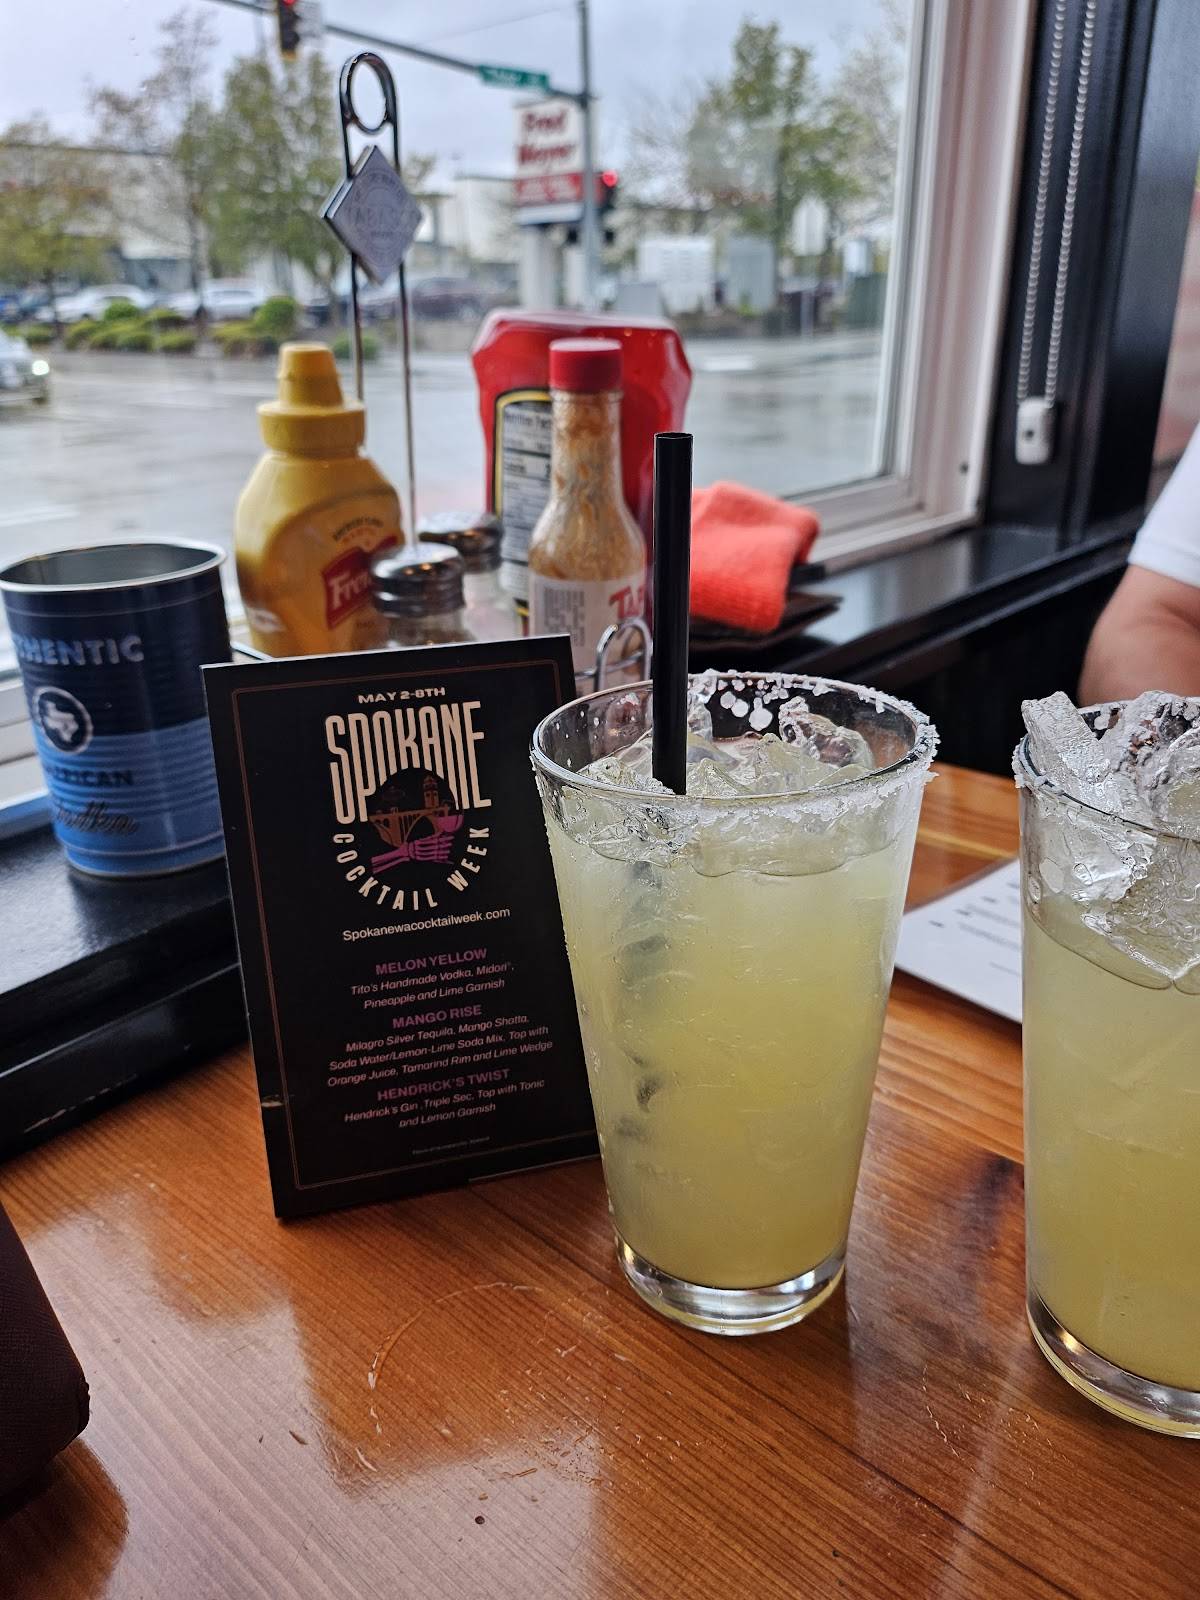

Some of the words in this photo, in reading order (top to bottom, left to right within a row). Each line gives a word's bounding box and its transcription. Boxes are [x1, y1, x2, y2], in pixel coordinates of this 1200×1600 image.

[358, 691, 397, 704] MAY
[400, 687, 446, 700] 2-8TH
[325, 701, 492, 824] SPOKANE
[333, 833, 438, 911] COCKTAIL
[447, 827, 490, 892] WEEK
[342, 908, 511, 941] Spokanewacocktailweek.com
[375, 957, 427, 976] MELON
[429, 948, 488, 966] YELLOW
[351, 982, 378, 996] Tito's
[381, 973, 437, 991] Handmade
[364, 993, 416, 1010] Pineapple
[417, 988, 437, 1001] and
[439, 985, 463, 998] Lime
[466, 978, 505, 994] Garnish
[392, 1010, 447, 1029] MANGO
[449, 1004, 482, 1021] RISE
[328, 1058, 357, 1072] Soda
[360, 1043, 455, 1067] Water/Lemon-Lime
[457, 1037, 484, 1050] Soda
[508, 1029, 527, 1043] Top
[528, 1025, 549, 1038] with
[345, 1038, 384, 1053] Milagro
[386, 1033, 416, 1046] Silver
[458, 1020, 492, 1035] Mango
[327, 1072, 367, 1088] Orange
[401, 1058, 449, 1075] Tamarind
[451, 1053, 472, 1067] Rim
[473, 1049, 492, 1062] and
[493, 1044, 518, 1058] Lime
[519, 1039, 553, 1054] Wedge
[344, 1105, 398, 1122] Hendrick's
[400, 1101, 418, 1114] Gin
[477, 1087, 496, 1101] Top
[497, 1083, 517, 1095] with
[519, 1078, 545, 1092] Tonic
[377, 1077, 465, 1101] HENDRICK'S
[467, 1068, 511, 1086] TWIST
[399, 1115, 419, 1128] and
[420, 1110, 455, 1125] Lemon
[457, 1102, 496, 1119] Garnish
